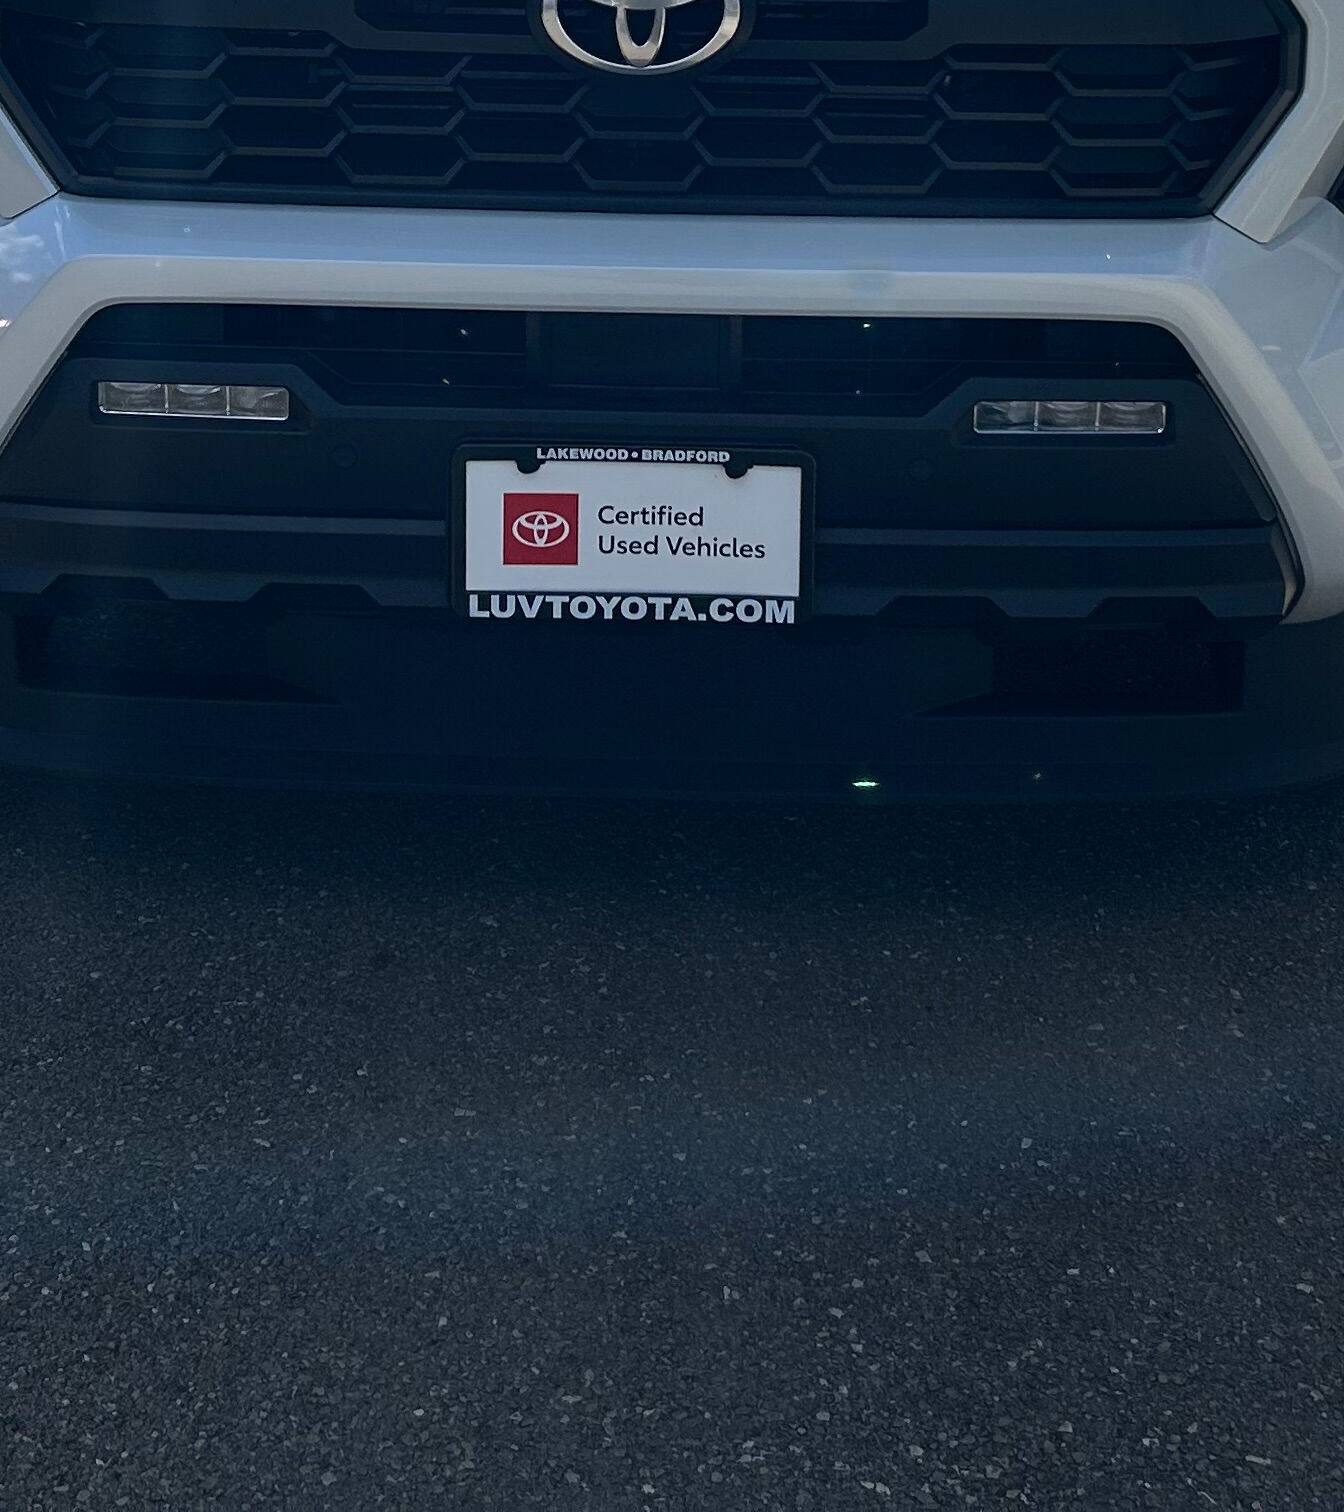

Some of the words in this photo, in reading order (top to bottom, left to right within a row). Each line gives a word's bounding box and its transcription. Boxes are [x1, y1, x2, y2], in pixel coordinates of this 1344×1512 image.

[536, 447, 629, 461] LAKEWOOD
[641, 449, 731, 463] BRADFORD
[597, 505, 705, 527] Certified
[597, 535, 659, 556] Used
[665, 536, 766, 559] Vehicles
[468, 593, 795, 625] LUVTOYOTA.COM
